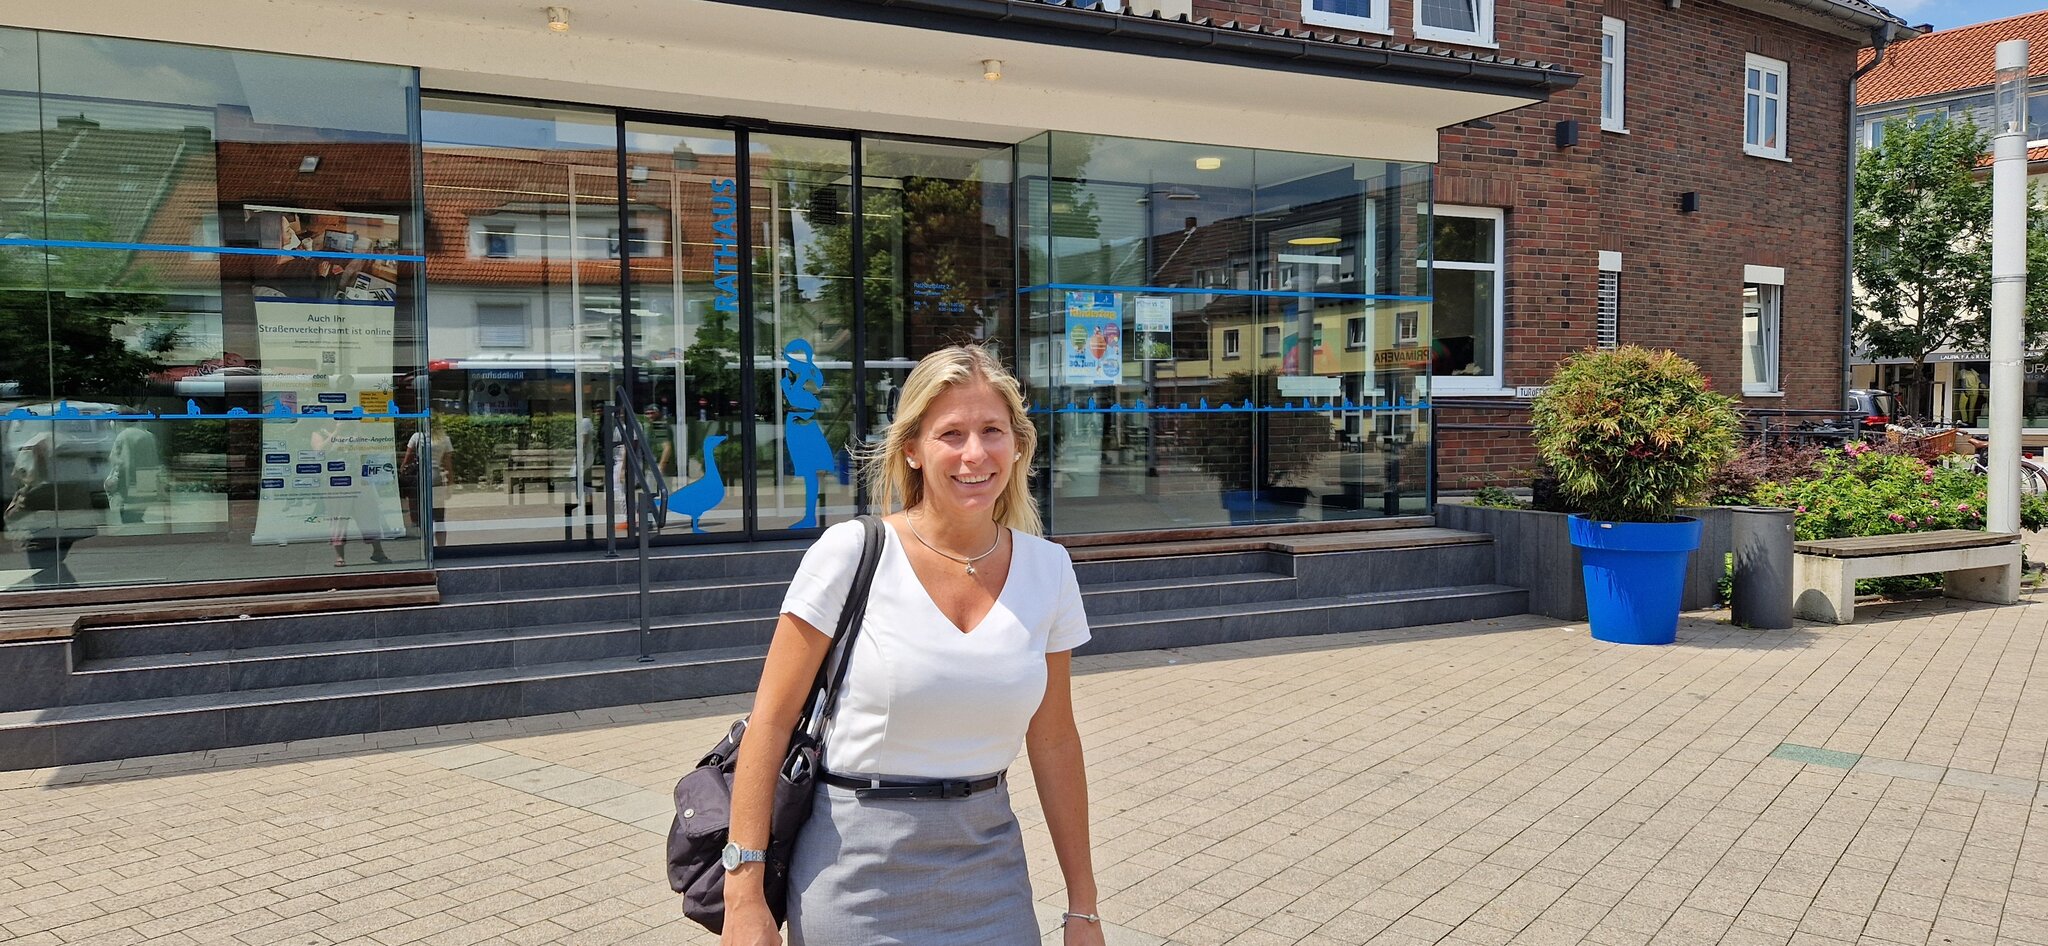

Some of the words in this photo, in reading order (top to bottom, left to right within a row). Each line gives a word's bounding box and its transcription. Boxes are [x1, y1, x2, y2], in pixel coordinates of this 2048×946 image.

[711, 178, 738, 312] RATHAUS
[307, 314, 331, 323] Auch
[333, 315, 346, 323] Ihr
[259, 324, 349, 335] Straßenverkehrsamt
[365, 328, 392, 336] online
